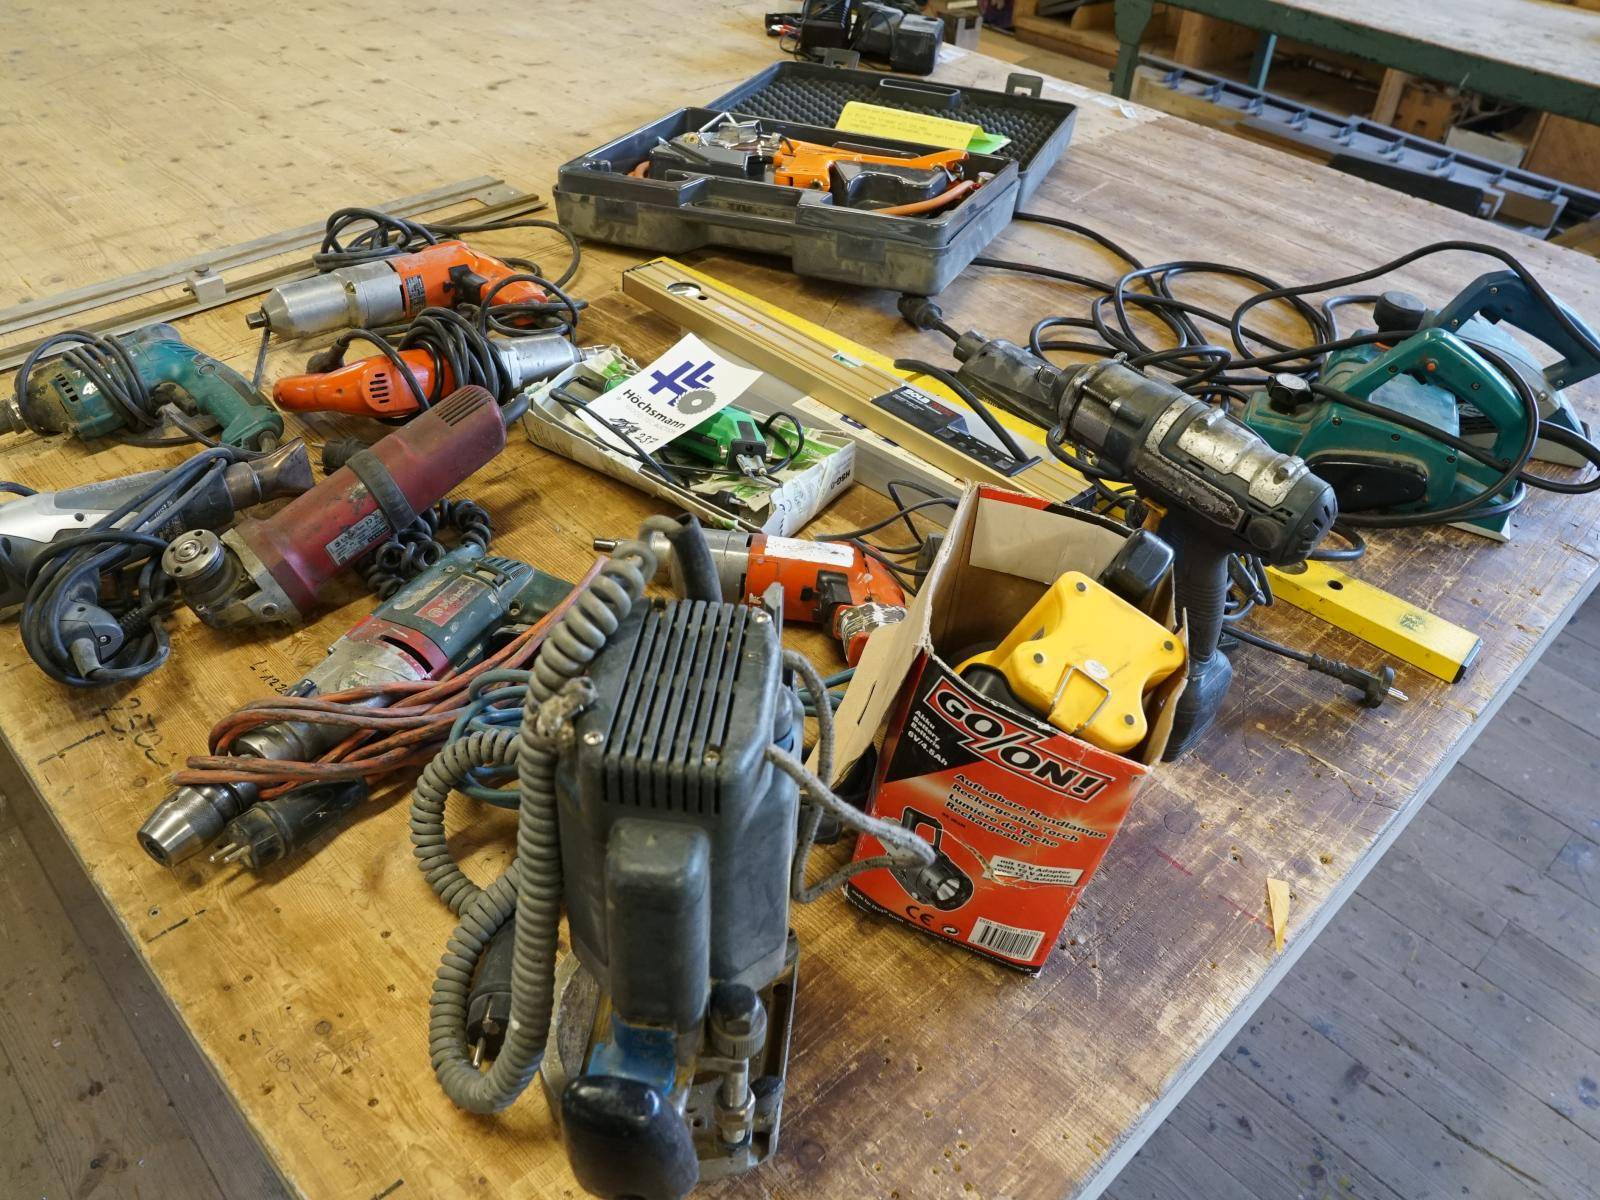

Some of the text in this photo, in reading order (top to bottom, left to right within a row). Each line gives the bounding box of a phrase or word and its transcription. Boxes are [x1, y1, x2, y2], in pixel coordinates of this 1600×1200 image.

[622, 389, 686, 429] Höchsmann
[910, 721, 940, 750] Batterie
[912, 715, 940, 742] Battery
[914, 710, 936, 730] Akku
[948, 793, 998, 823] Lumière
[1001, 820, 1017, 832] de
[1020, 829, 1059, 848] Tache
[952, 784, 1039, 830] Rechargeable
[1043, 826, 1080, 843] Torch
[955, 774, 1107, 839] Aufladbare Handlampe
[945, 801, 1032, 848] Rechargeable
[1036, 867, 1071, 875] Adapter
[1037, 872, 1071, 880] Adapter
